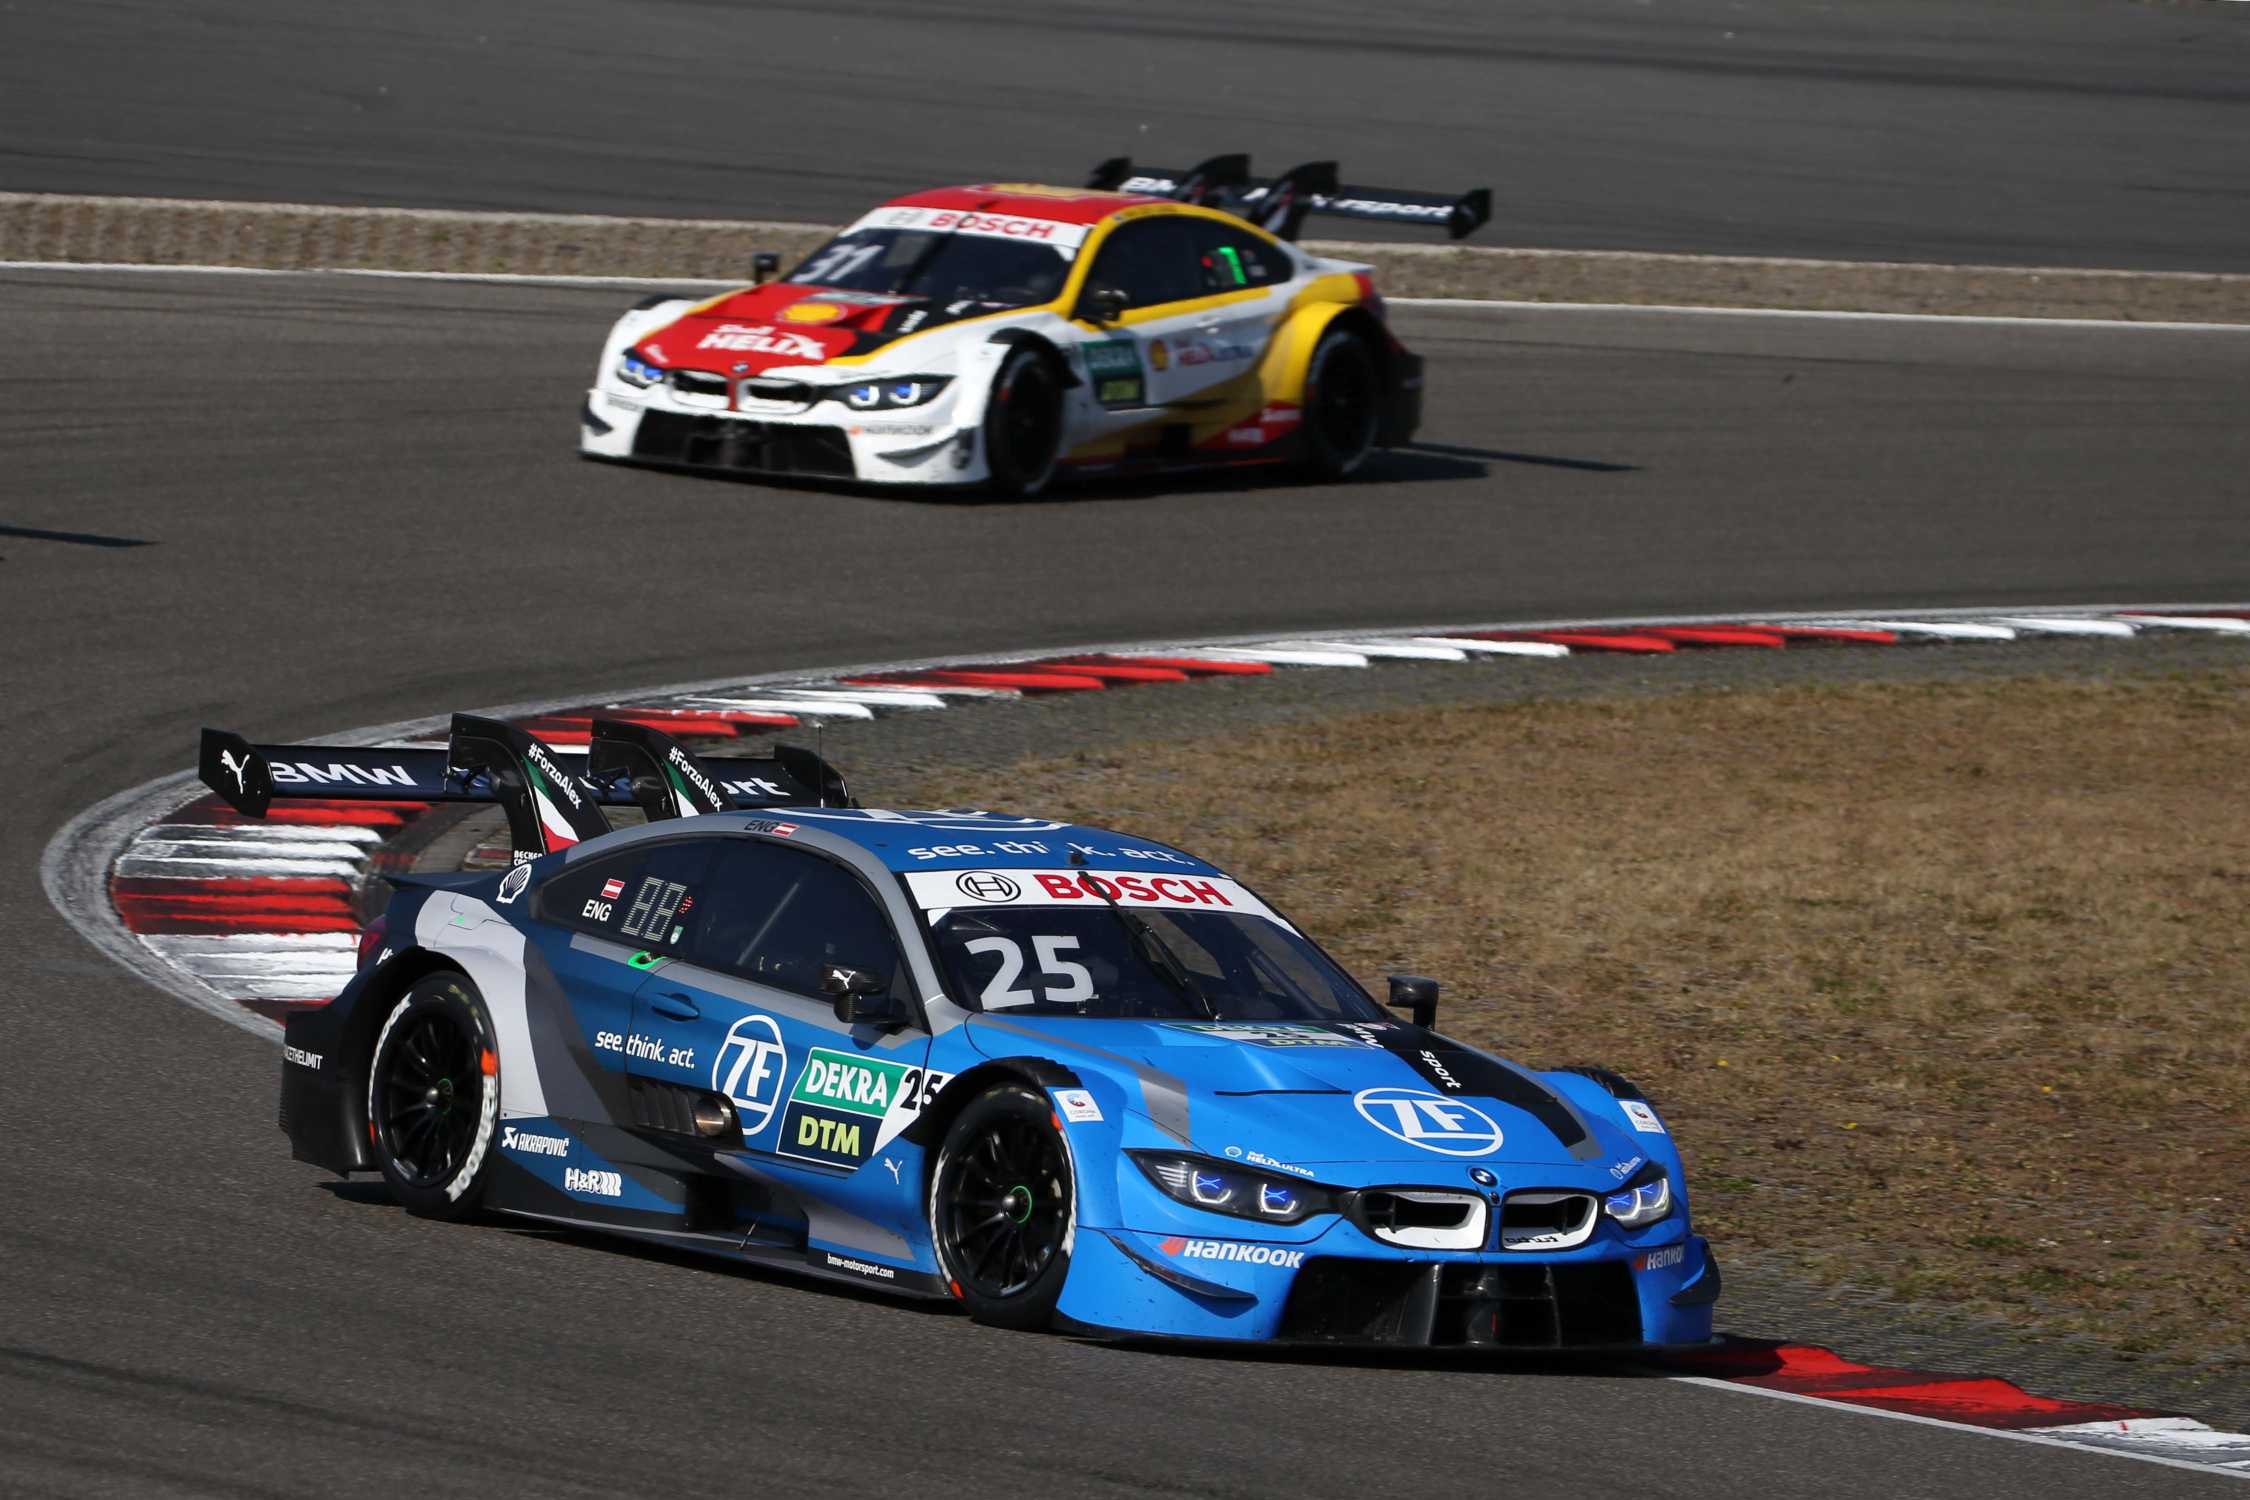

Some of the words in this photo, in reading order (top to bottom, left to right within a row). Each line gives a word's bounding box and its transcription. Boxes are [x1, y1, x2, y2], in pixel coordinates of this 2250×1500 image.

[929, 213, 1055, 239] BOSCH
[792, 244, 884, 282] 31
[696, 331, 826, 361] HELIX
[269, 761, 419, 787] BMW
[527, 742, 583, 811] #ForzaAlex
[668, 746, 723, 813] #ForzaAlex
[743, 820, 778, 832] ENG
[907, 842, 997, 861] see.
[994, 840, 1117, 859] thik.
[1118, 846, 1197, 868] act.
[1032, 873, 1235, 907] BOSCH
[581, 899, 613, 922] ENG
[964, 935, 1097, 1012] 25
[595, 1030, 623, 1053] see.
[625, 1033, 665, 1063] think.
[668, 1046, 696, 1069] act.
[804, 1058, 888, 1108] DEKRA
[1419, 1048, 1463, 1089] sport
[899, 1069, 943, 1111] 25
[797, 1114, 860, 1157] DTM
[565, 1167, 603, 1194] H&R
[827, 1252, 895, 1279] bmw-motorsport.com
